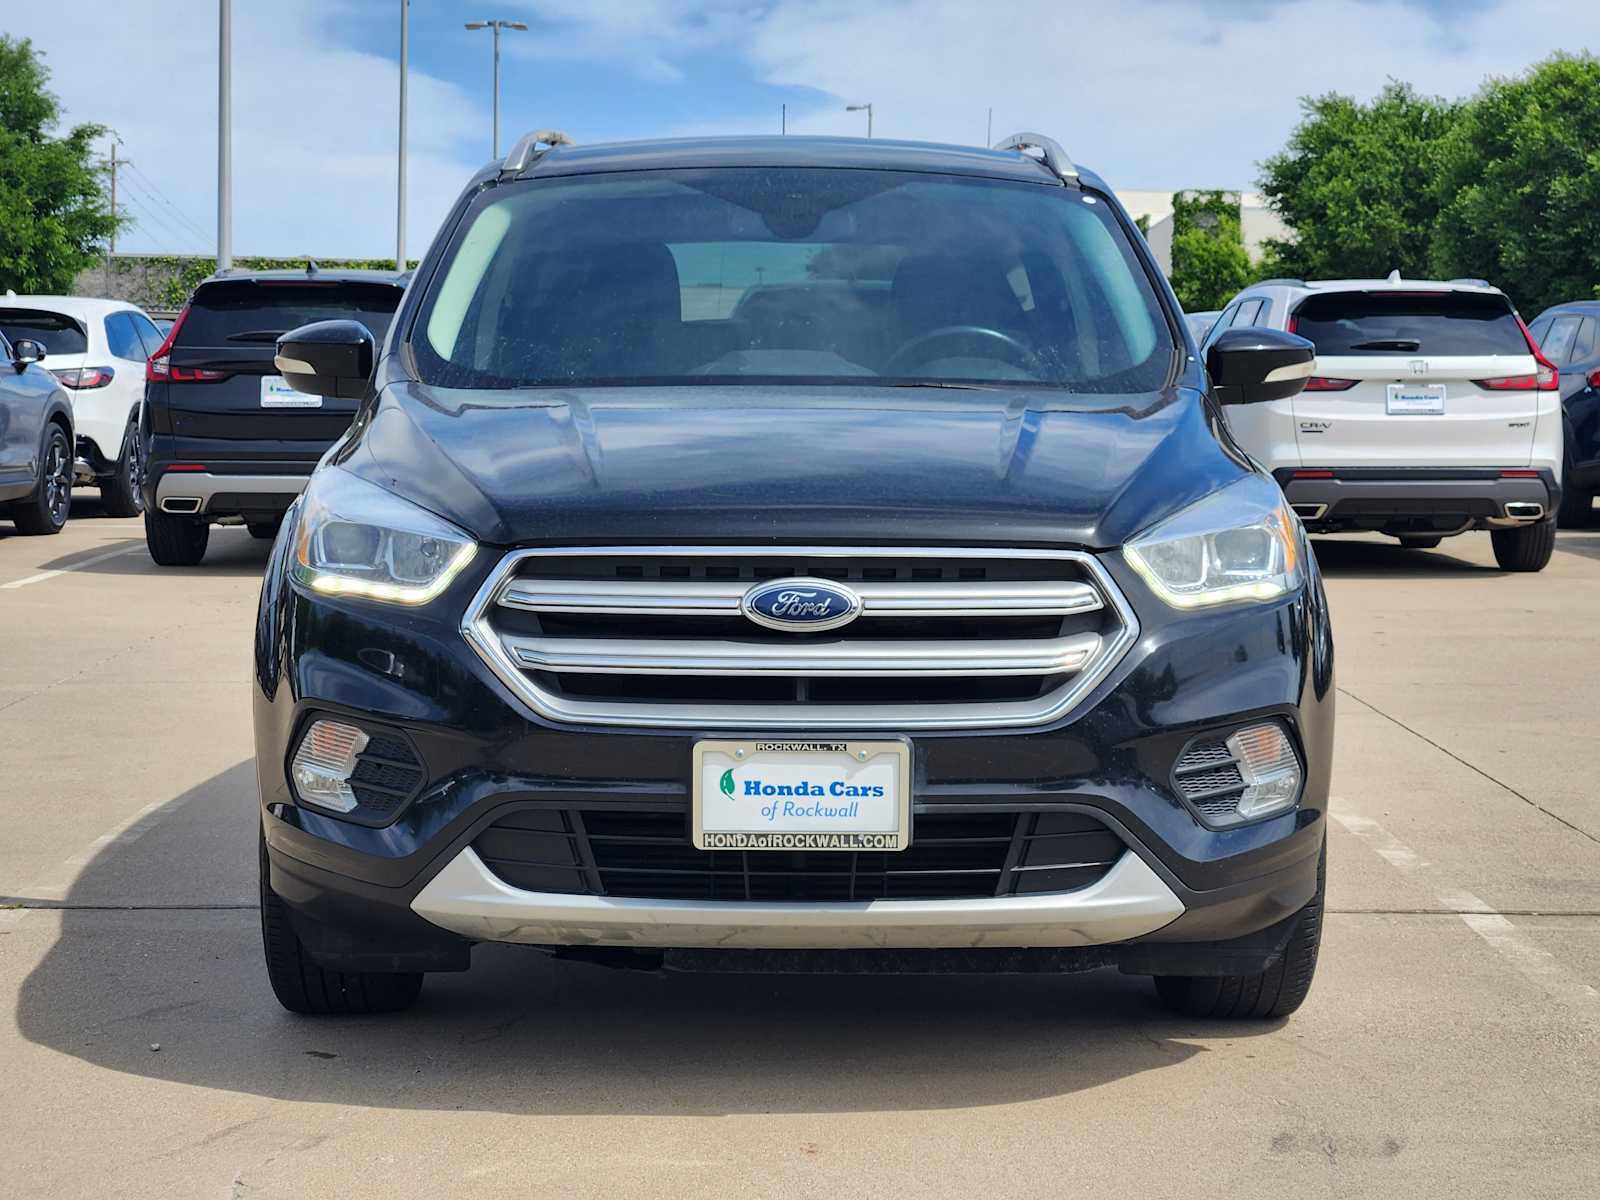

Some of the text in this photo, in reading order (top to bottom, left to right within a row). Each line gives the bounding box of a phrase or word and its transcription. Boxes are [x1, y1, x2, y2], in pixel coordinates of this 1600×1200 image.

[771, 590, 831, 616] Ford
[830, 743, 846, 751] TX
[744, 780, 884, 797] Honda Cars
[761, 801, 858, 821] of Rockwall
